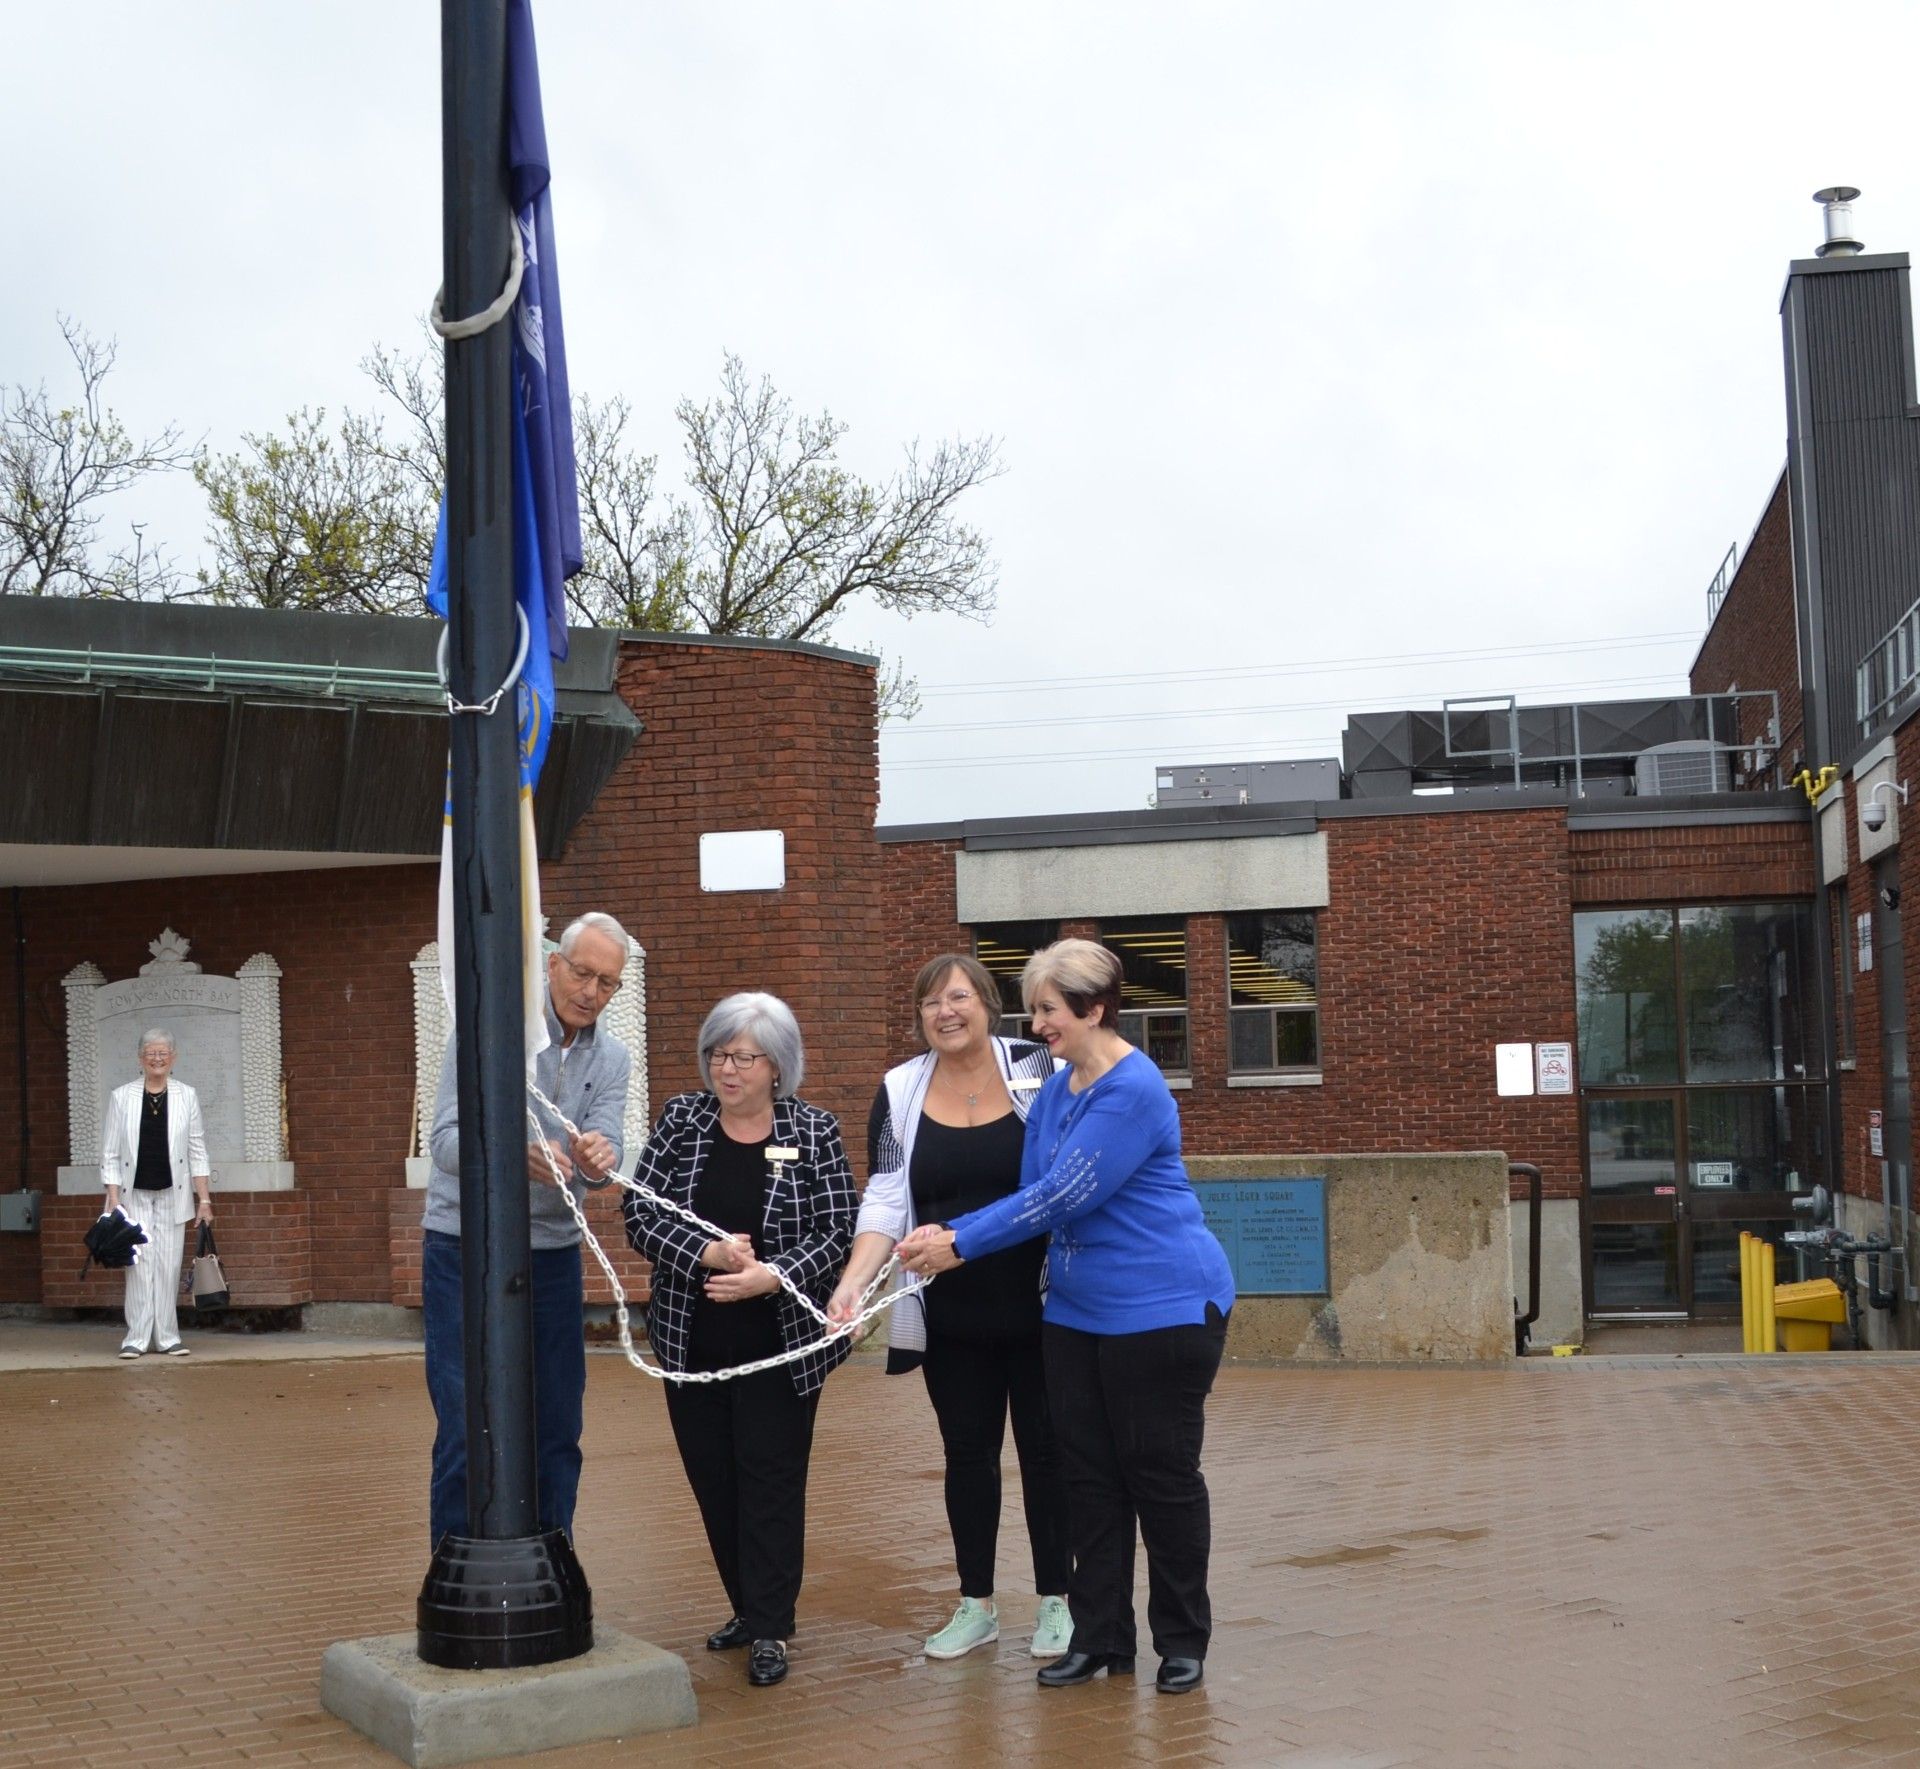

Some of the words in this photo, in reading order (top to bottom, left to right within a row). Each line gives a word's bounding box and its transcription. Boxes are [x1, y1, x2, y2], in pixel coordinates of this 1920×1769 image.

[107, 990, 143, 1009] TOWN
[163, 988, 203, 1001] NORTH
[210, 990, 232, 1004] BAY
[1704, 1174, 1725, 1183] ONLY
[1264, 1191, 1294, 1201] SQUARE
